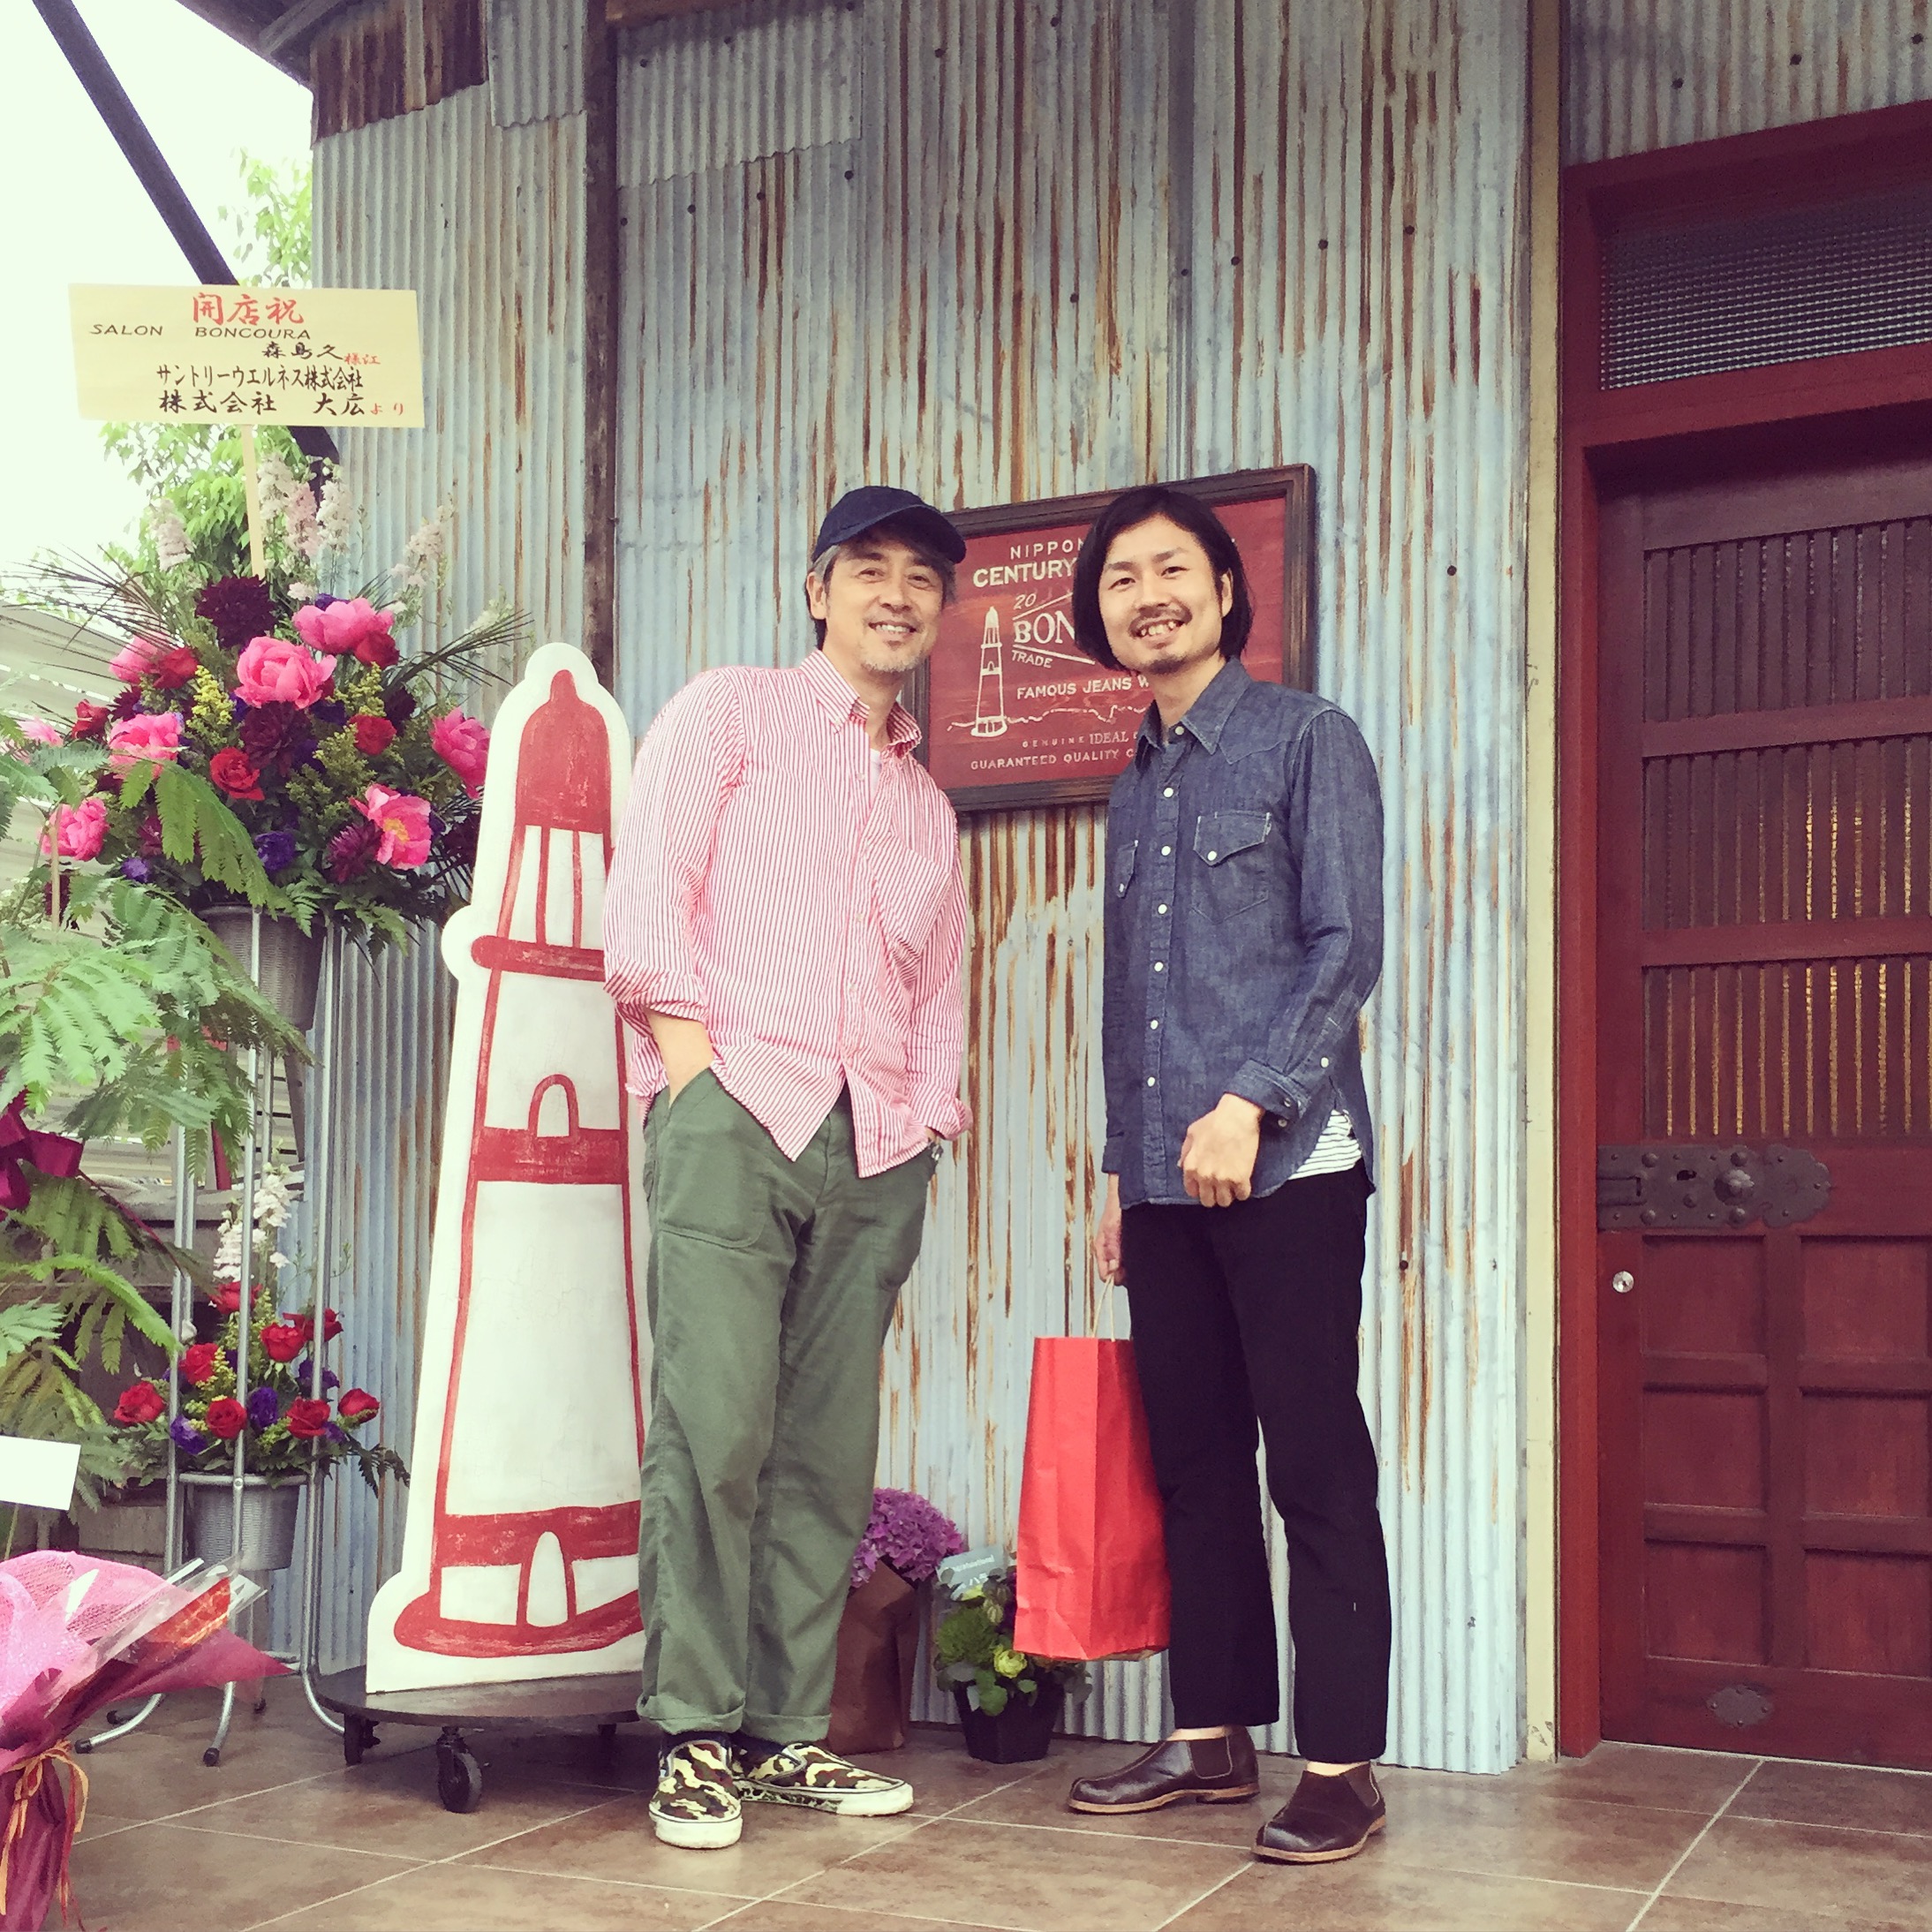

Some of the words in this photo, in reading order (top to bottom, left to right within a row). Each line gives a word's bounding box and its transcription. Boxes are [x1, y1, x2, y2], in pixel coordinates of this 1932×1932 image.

[192, 292, 305, 326] 開店祝
[89, 324, 163, 336] SALON
[195, 327, 311, 340] BONCOURA
[158, 389, 277, 415] 株式会社
[972, 557, 1077, 588] CENTURY
[1013, 592, 1038, 610] 20
[1011, 649, 1053, 669] TRADE
[1016, 683, 1077, 700] FAMOUS
[1083, 676, 1132, 694] JEANS
[1089, 730, 1129, 745] IDEAL
[970, 755, 1057, 771] GUARANTEED
[1063, 749, 1120, 764] QUALITY
